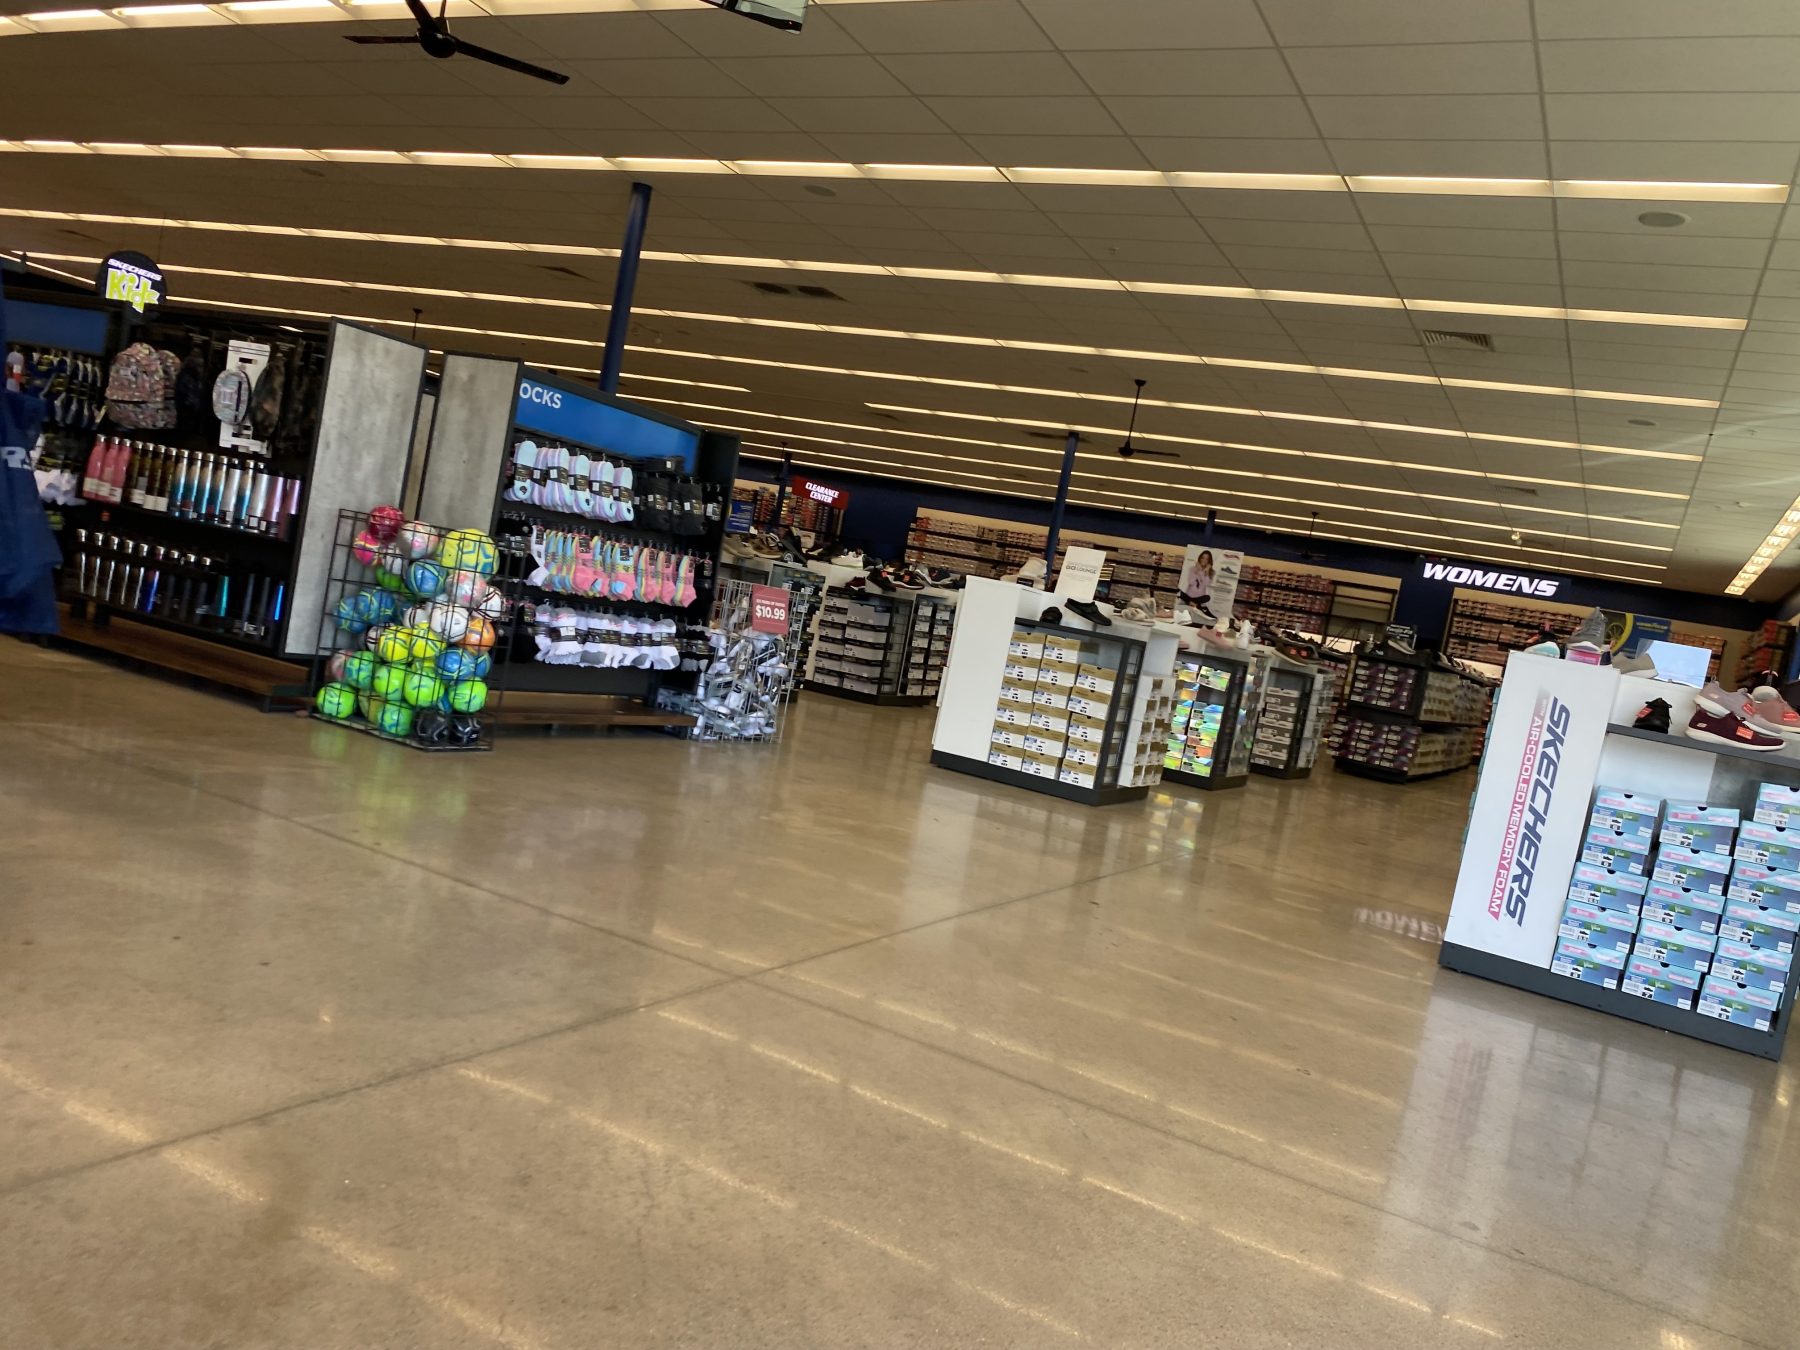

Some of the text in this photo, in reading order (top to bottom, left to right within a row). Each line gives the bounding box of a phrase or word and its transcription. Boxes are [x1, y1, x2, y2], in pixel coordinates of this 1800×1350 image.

[105, 267, 161, 313] Kids
[805, 481, 840, 499] CLEARANCE
[809, 490, 833, 504] CENTER
[1422, 562, 1560, 597] WOMENS
[755, 604, 786, 621] $10.99
[1505, 696, 1570, 928] SKECHERS
[1500, 803, 1523, 869] MEMORY
[1489, 869, 1509, 913] FOAM
